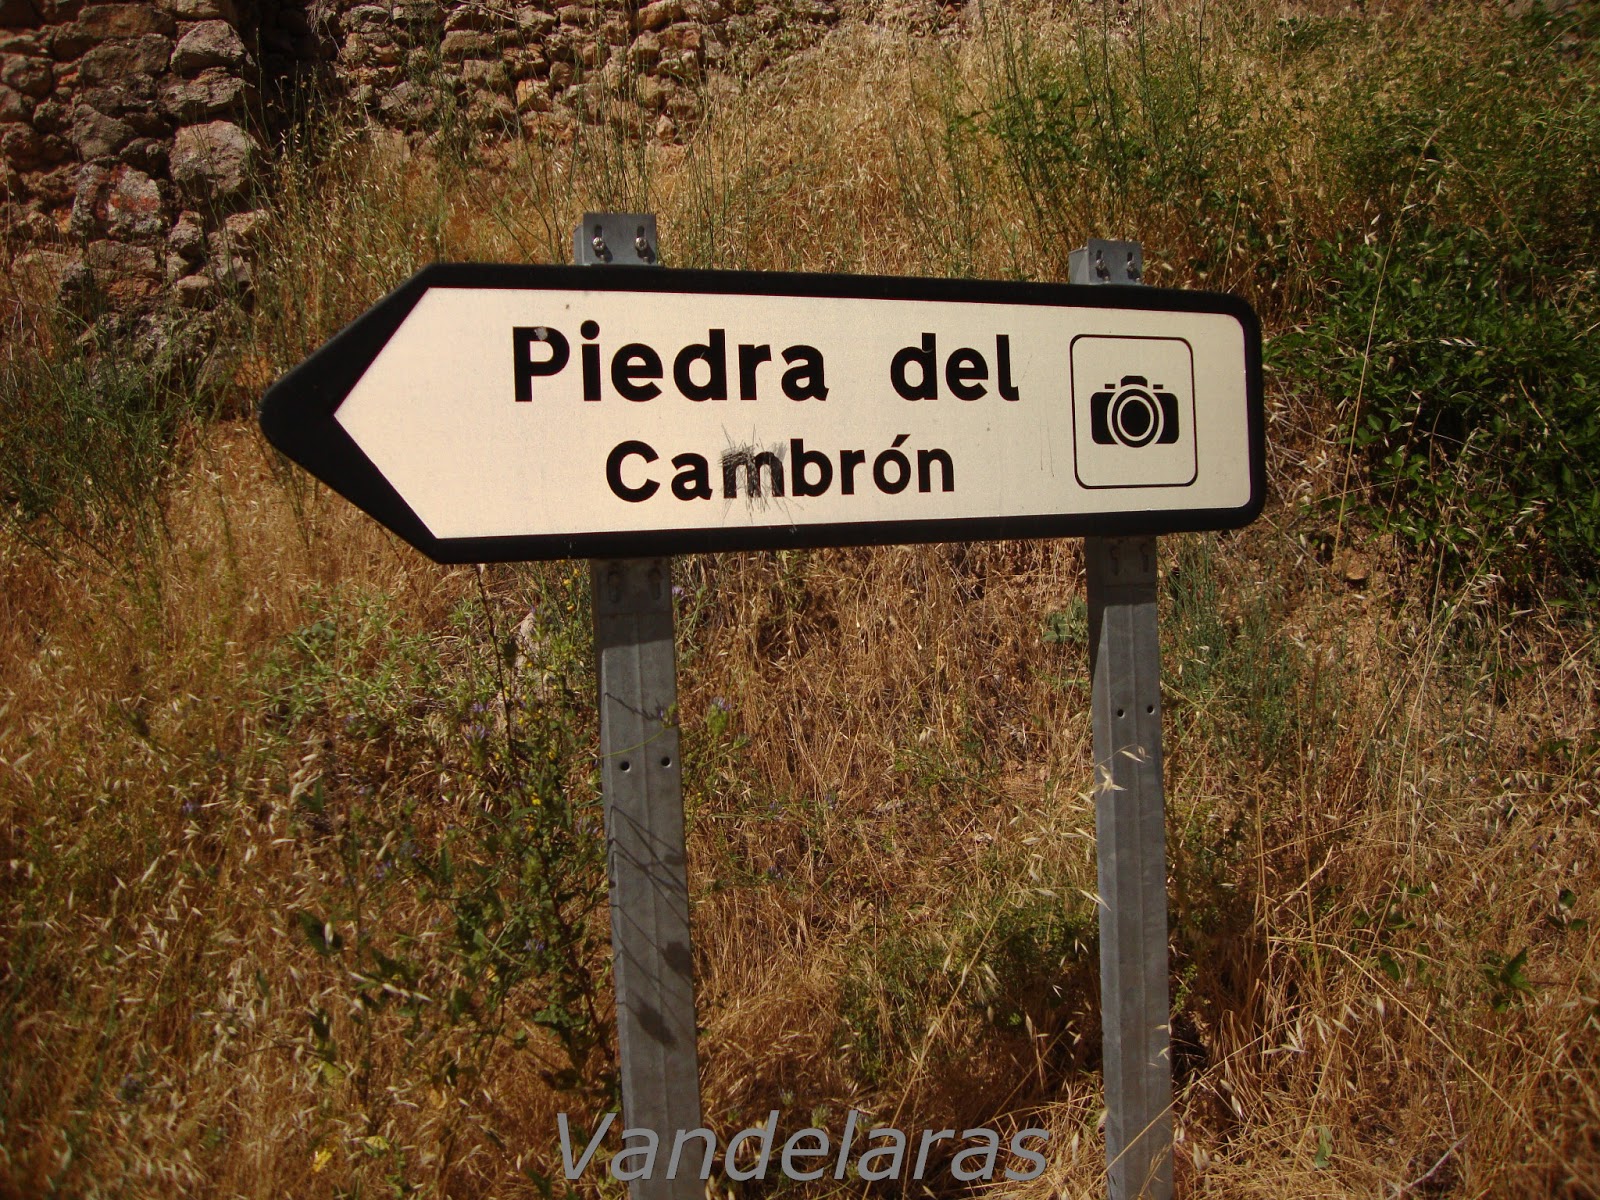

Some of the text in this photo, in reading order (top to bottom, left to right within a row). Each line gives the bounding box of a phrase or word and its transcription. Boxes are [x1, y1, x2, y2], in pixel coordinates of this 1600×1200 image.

[513, 320, 1020, 402] Piedra del
[606, 434, 955, 502] Cambrón
